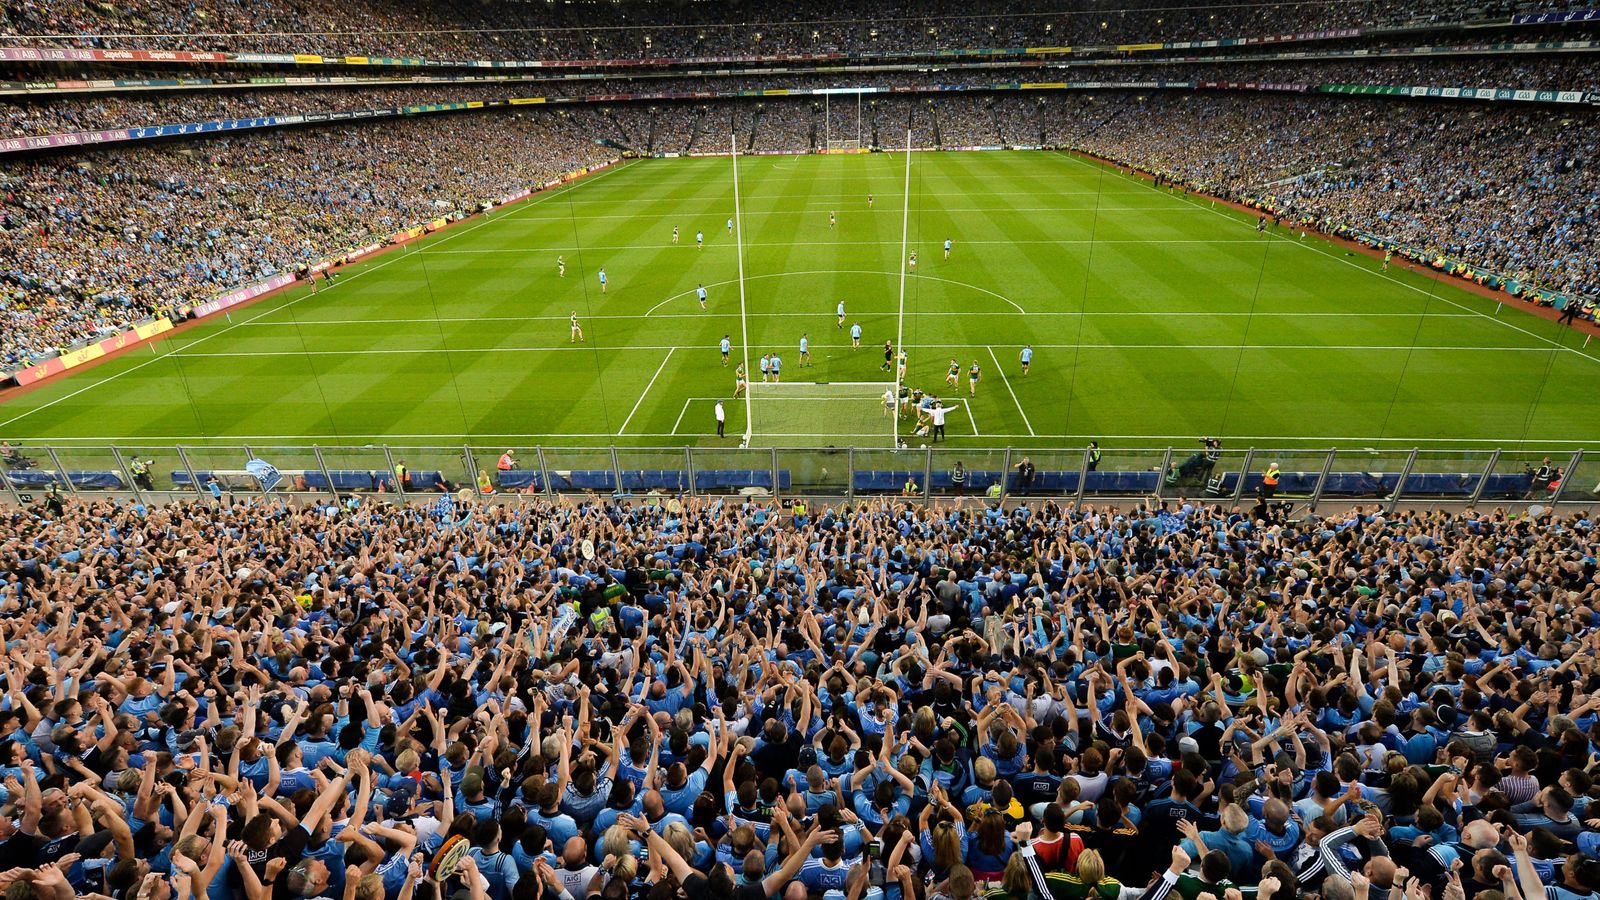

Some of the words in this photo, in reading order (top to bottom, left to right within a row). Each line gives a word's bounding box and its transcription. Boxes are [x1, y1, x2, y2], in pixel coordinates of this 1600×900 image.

[22, 50, 37, 59] AIB
[51, 50, 66, 59] AIB
[79, 51, 92, 59] AIB
[64, 136, 77, 144] AIB
[91, 133, 103, 141] AIB
[7, 140, 20, 149] AIB
[36, 138, 50, 146] AIB
